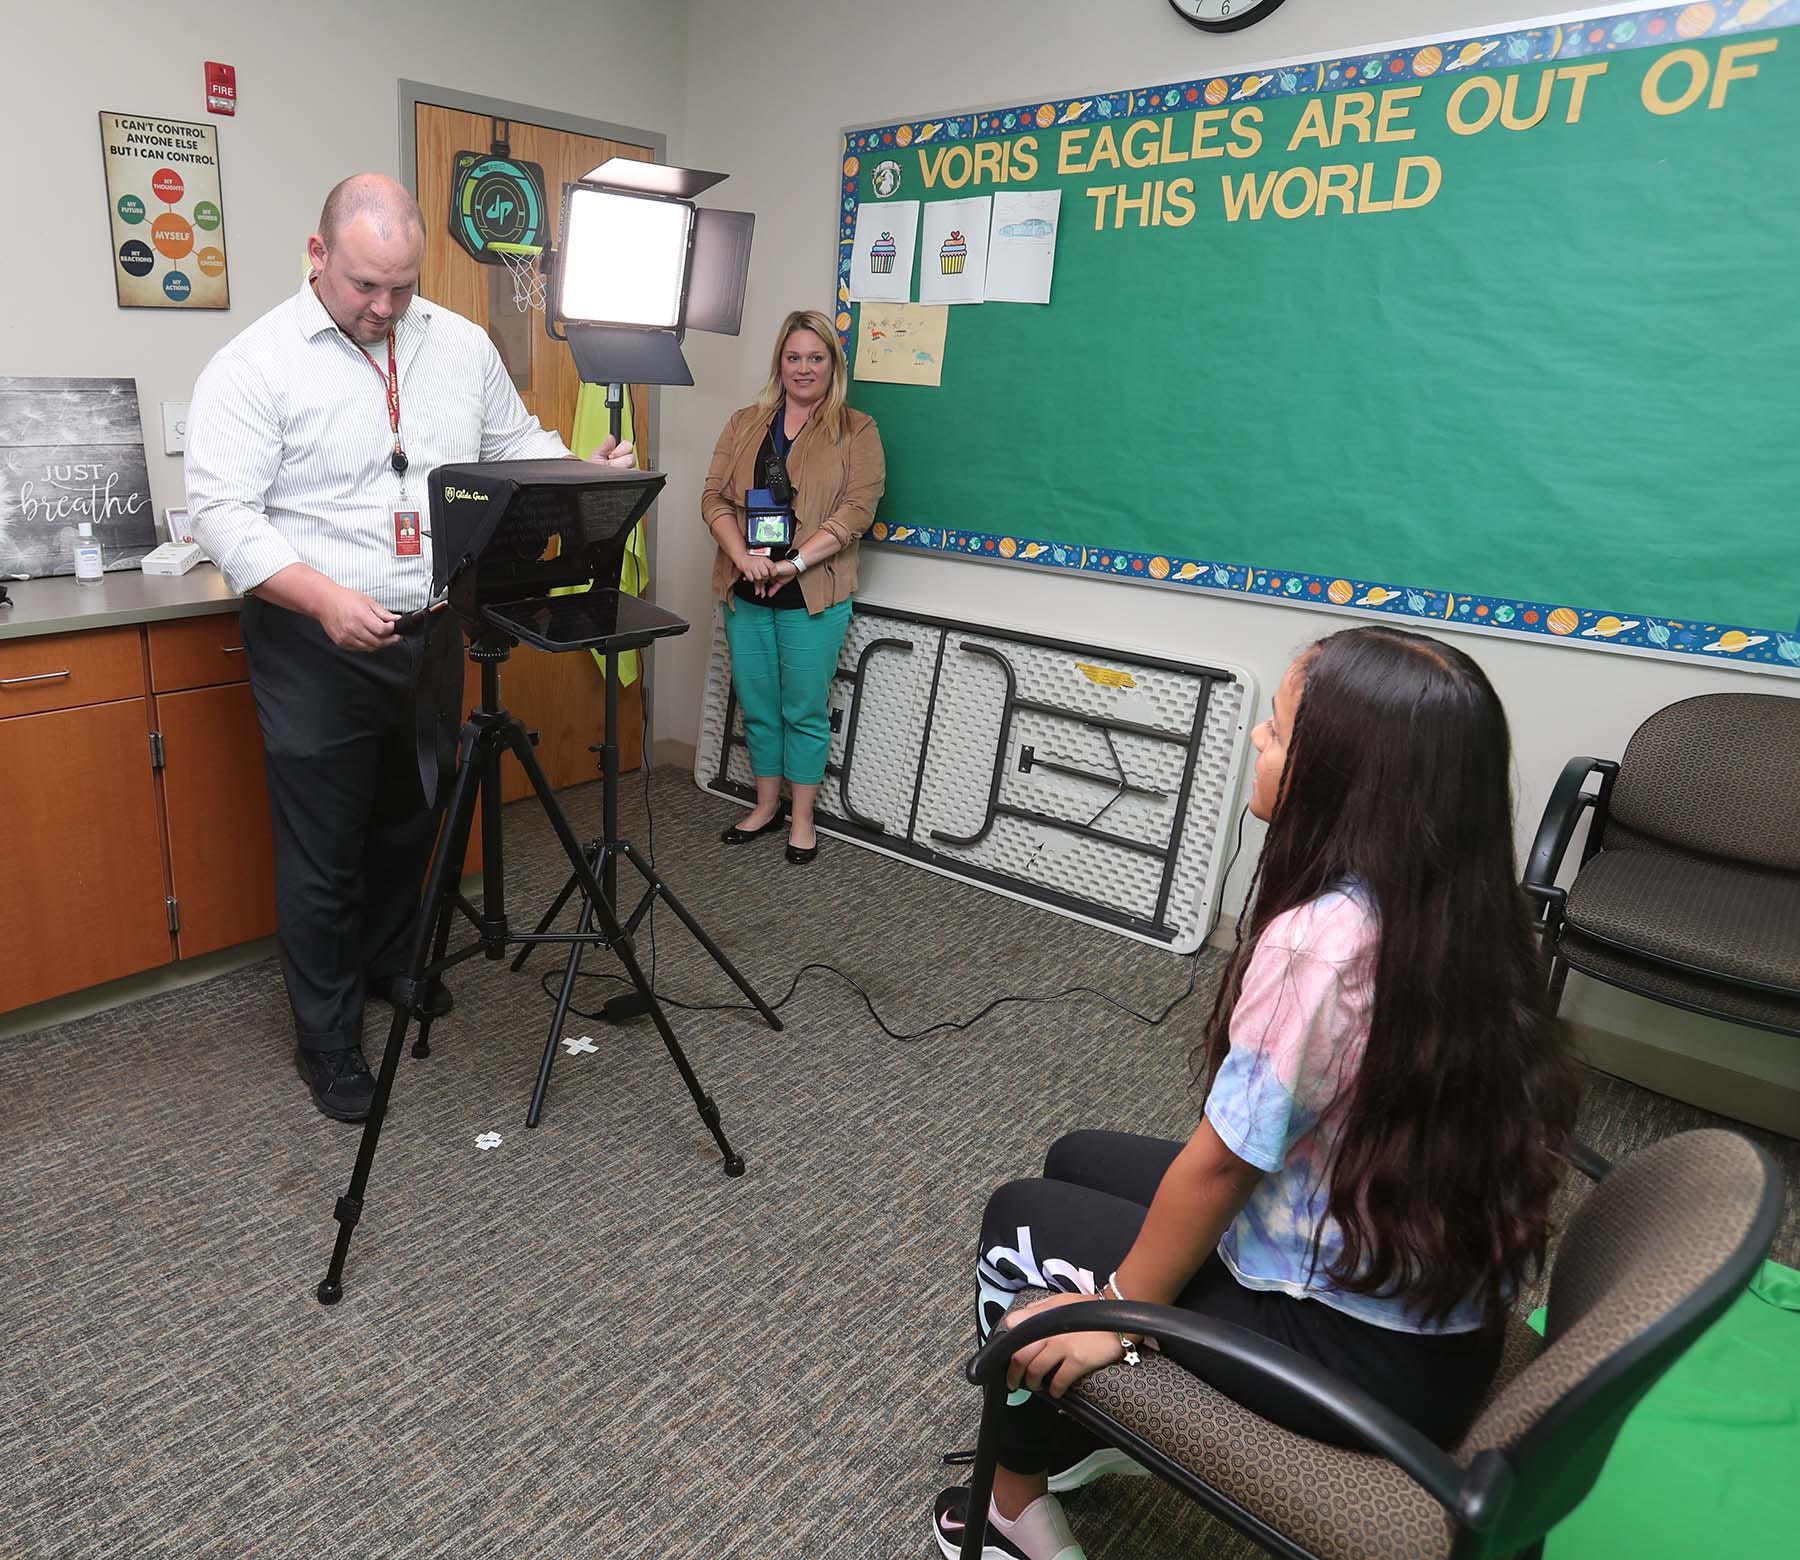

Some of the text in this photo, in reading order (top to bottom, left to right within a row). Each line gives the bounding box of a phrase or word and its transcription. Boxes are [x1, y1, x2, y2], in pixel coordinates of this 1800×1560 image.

[1221, 0, 1230, 15] 6
[212, 84, 234, 97] FIRE
[917, 38, 1779, 189] VORIS EAGLES ARE OUT OF
[115, 119, 206, 139] I CAN'T CONTROL
[127, 133, 198, 150] ANYONE ELSE
[110, 145, 215, 165] BUT I CAN CONTROL
[1085, 155, 1443, 231] THIS WORLD
[155, 231, 191, 241] MYSELF
[41, 463, 103, 481] JUST
[15, 472, 152, 524] breathe
